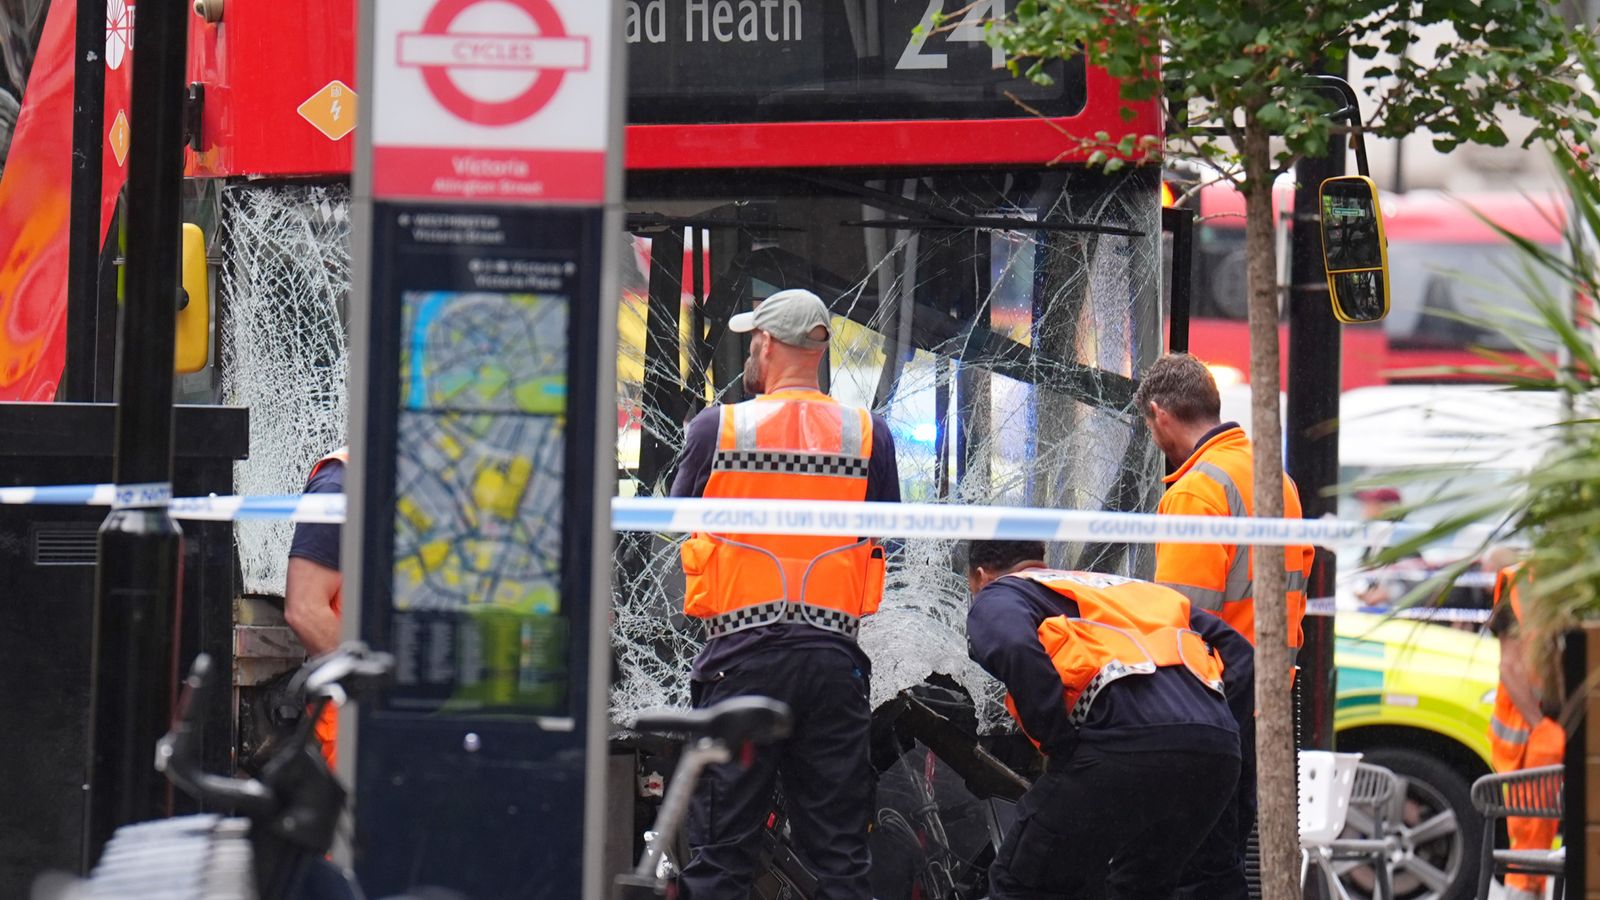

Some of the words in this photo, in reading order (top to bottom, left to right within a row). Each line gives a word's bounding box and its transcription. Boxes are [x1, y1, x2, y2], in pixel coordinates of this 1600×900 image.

[685, 0, 802, 42] Heath
[894, 0, 1006, 70] 24
[452, 42, 534, 62] CYCLES
[452, 157, 529, 177] Victoria
